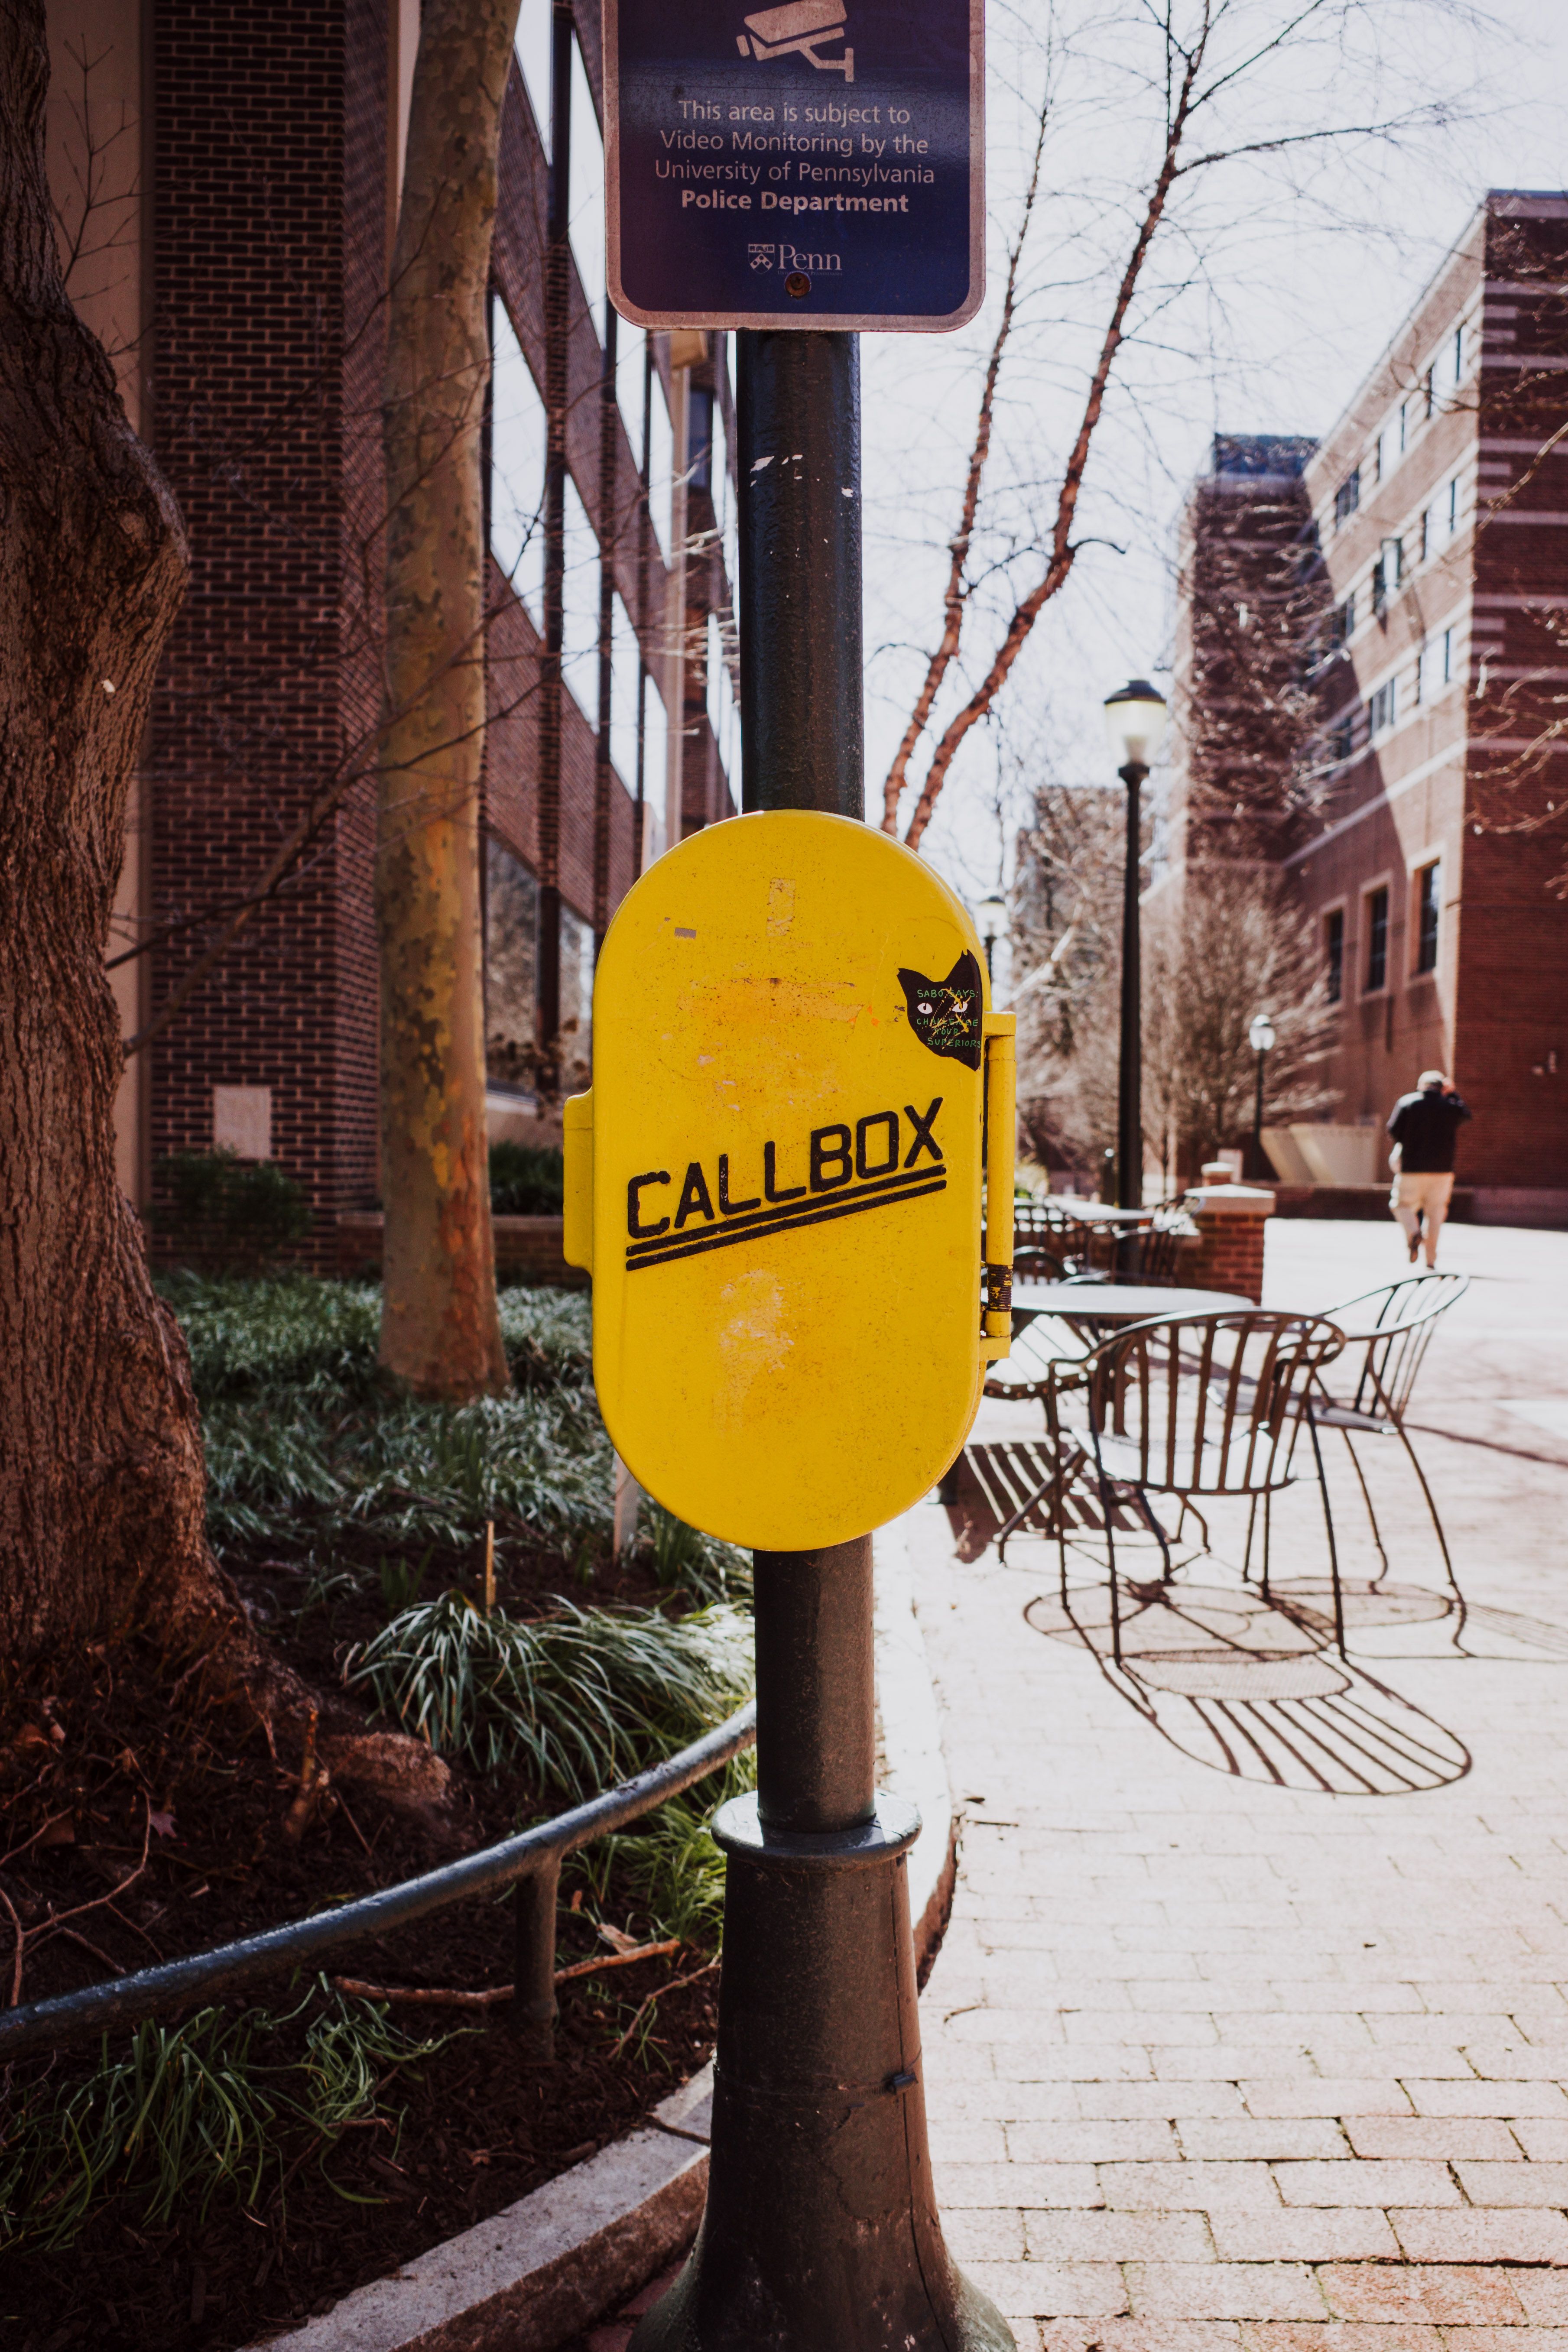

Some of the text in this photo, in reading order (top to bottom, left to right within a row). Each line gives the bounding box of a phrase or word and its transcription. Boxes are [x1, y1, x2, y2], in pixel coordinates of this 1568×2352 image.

[678, 100, 910, 128] This area is subject to
[660, 130, 928, 158] Video Monitoring by the
[655, 159, 934, 187] University of Pennsylvania
[682, 189, 909, 215] Police Department
[778, 244, 842, 270] Penn
[917, 989, 944, 998] SABO
[927, 1037, 981, 1048] SUPERIORS
[627, 1097, 943, 1239] CALLBOX
